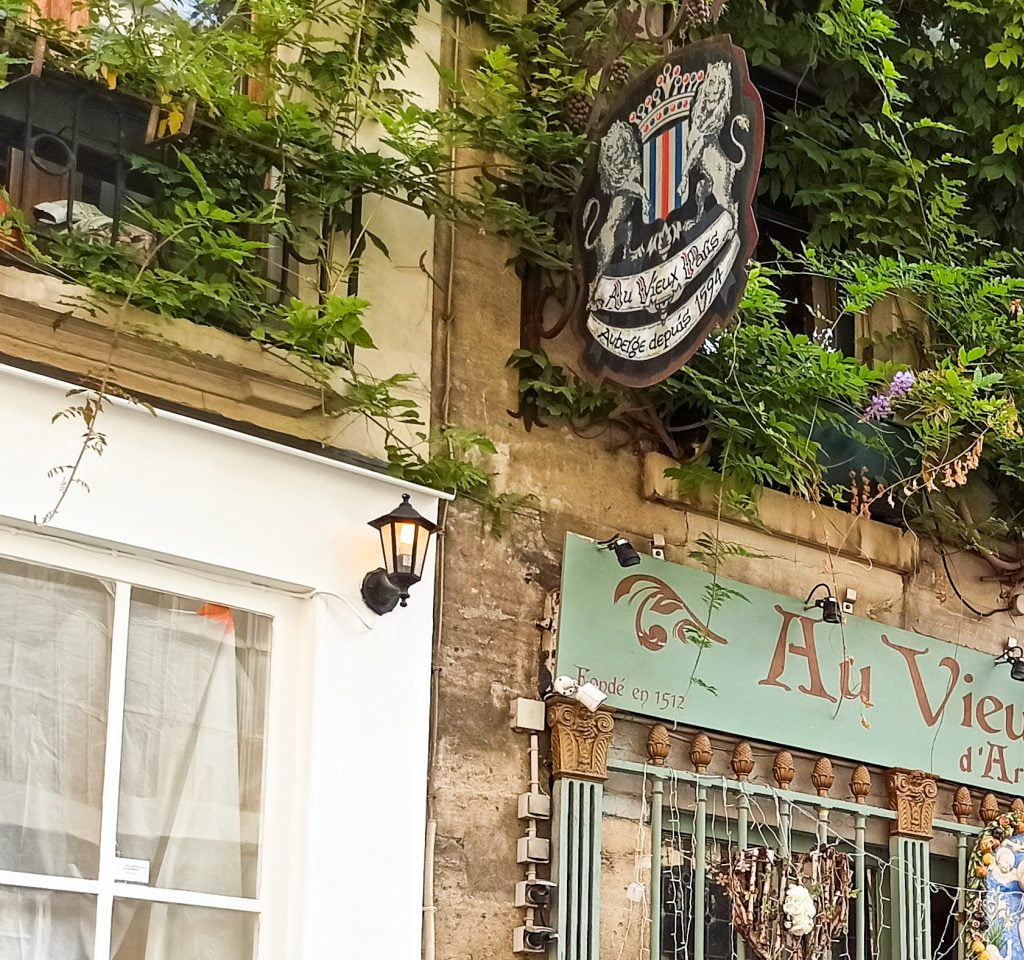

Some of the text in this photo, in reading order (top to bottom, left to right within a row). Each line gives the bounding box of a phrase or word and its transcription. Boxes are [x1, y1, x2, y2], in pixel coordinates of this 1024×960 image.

[597, 267, 723, 358] Auberge depuis 1594
[605, 231, 719, 310] Au Vieux Paris
[758, 604, 873, 708] Au
[632, 687, 649, 709] en
[655, 691, 685, 711] 1512
